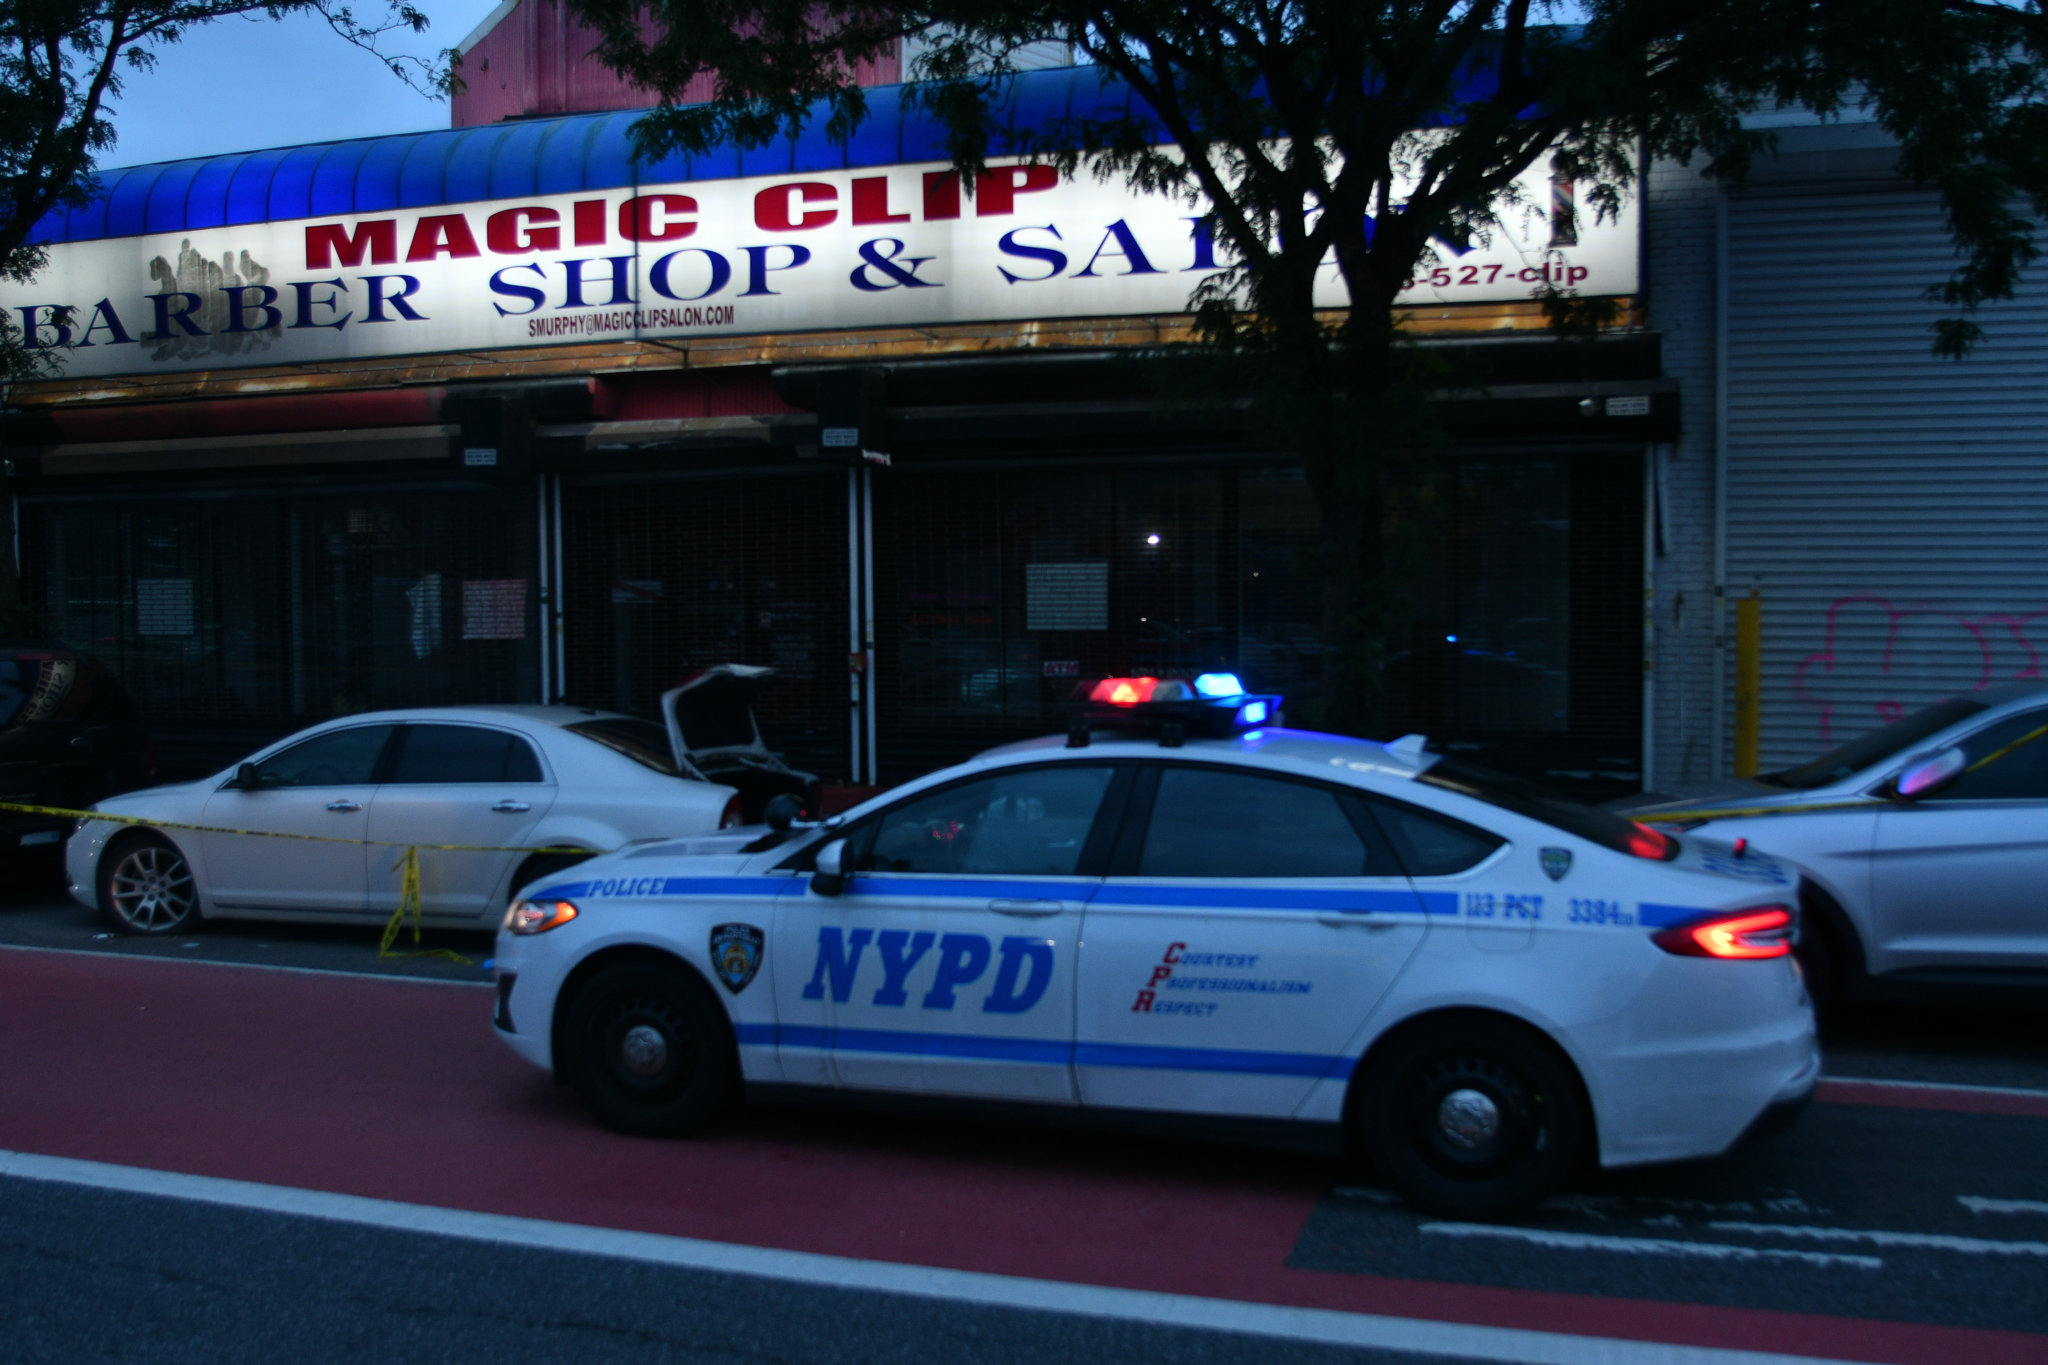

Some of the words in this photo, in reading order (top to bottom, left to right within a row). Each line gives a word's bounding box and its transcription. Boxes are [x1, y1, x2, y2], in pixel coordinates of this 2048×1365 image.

[305, 193, 699, 270] MAGIC
[754, 164, 1058, 232] CLIP
[14, 274, 430, 349] BARBER
[488, 243, 811, 317] SHOP
[849, 237, 945, 292] &
[998, 203, 1478, 285] SAL
[529, 305, 734, 338] SMURPHY@MAGICCLIPSALON.COM
[589, 877, 665, 897] POLICE
[1504, 894, 1543, 919] PCT
[802, 926, 1054, 1014] NYPD
[1148, 966, 1312, 993] PROFESSIONALISM
[1132, 990, 1217, 1014] RESPECT
